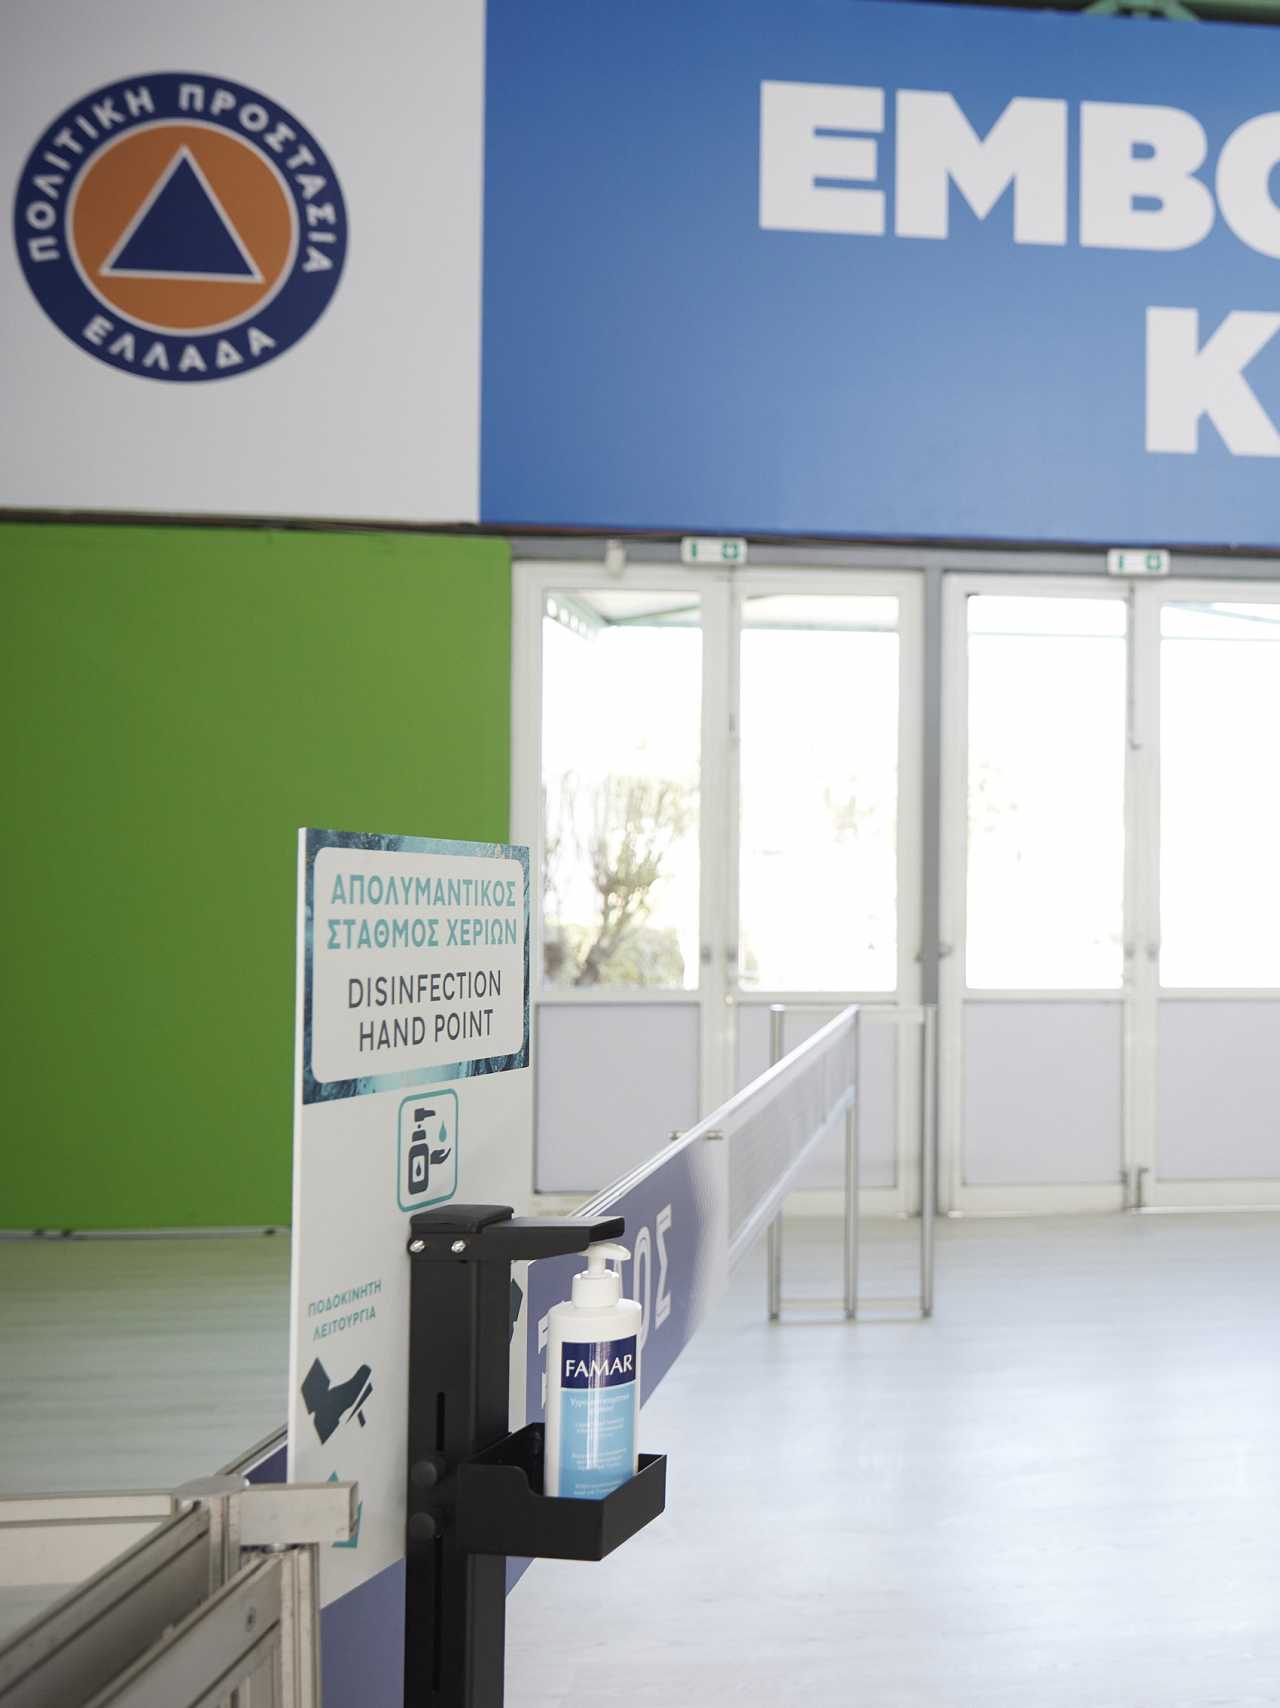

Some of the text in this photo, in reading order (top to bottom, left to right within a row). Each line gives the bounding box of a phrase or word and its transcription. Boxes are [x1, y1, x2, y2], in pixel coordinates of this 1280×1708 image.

[26, 83, 337, 272] ΠΟΛΙΤΙΚΗ ΠΡΟΣΤΑΣΙΑ
[82, 314, 277, 373] ΕΛΛΑΔΑ
[331, 873, 516, 907] ΑΠΟΛΥΜΑΝΤΙΚΟΣ
[327, 918, 517, 950] ΣΤΑΘΜΟΣ ΧΕΡΙΩΝ
[348, 969, 502, 1009] DISINFECTION
[359, 1008, 494, 1051] HAND POINT
[308, 1278, 383, 1317] ΠΟΔΟΚΙΝΗΤΗ
[313, 1304, 377, 1342] ΛΕΙΤΟΥΡΓΙΑ
[565, 1354, 633, 1378] FAMAR
